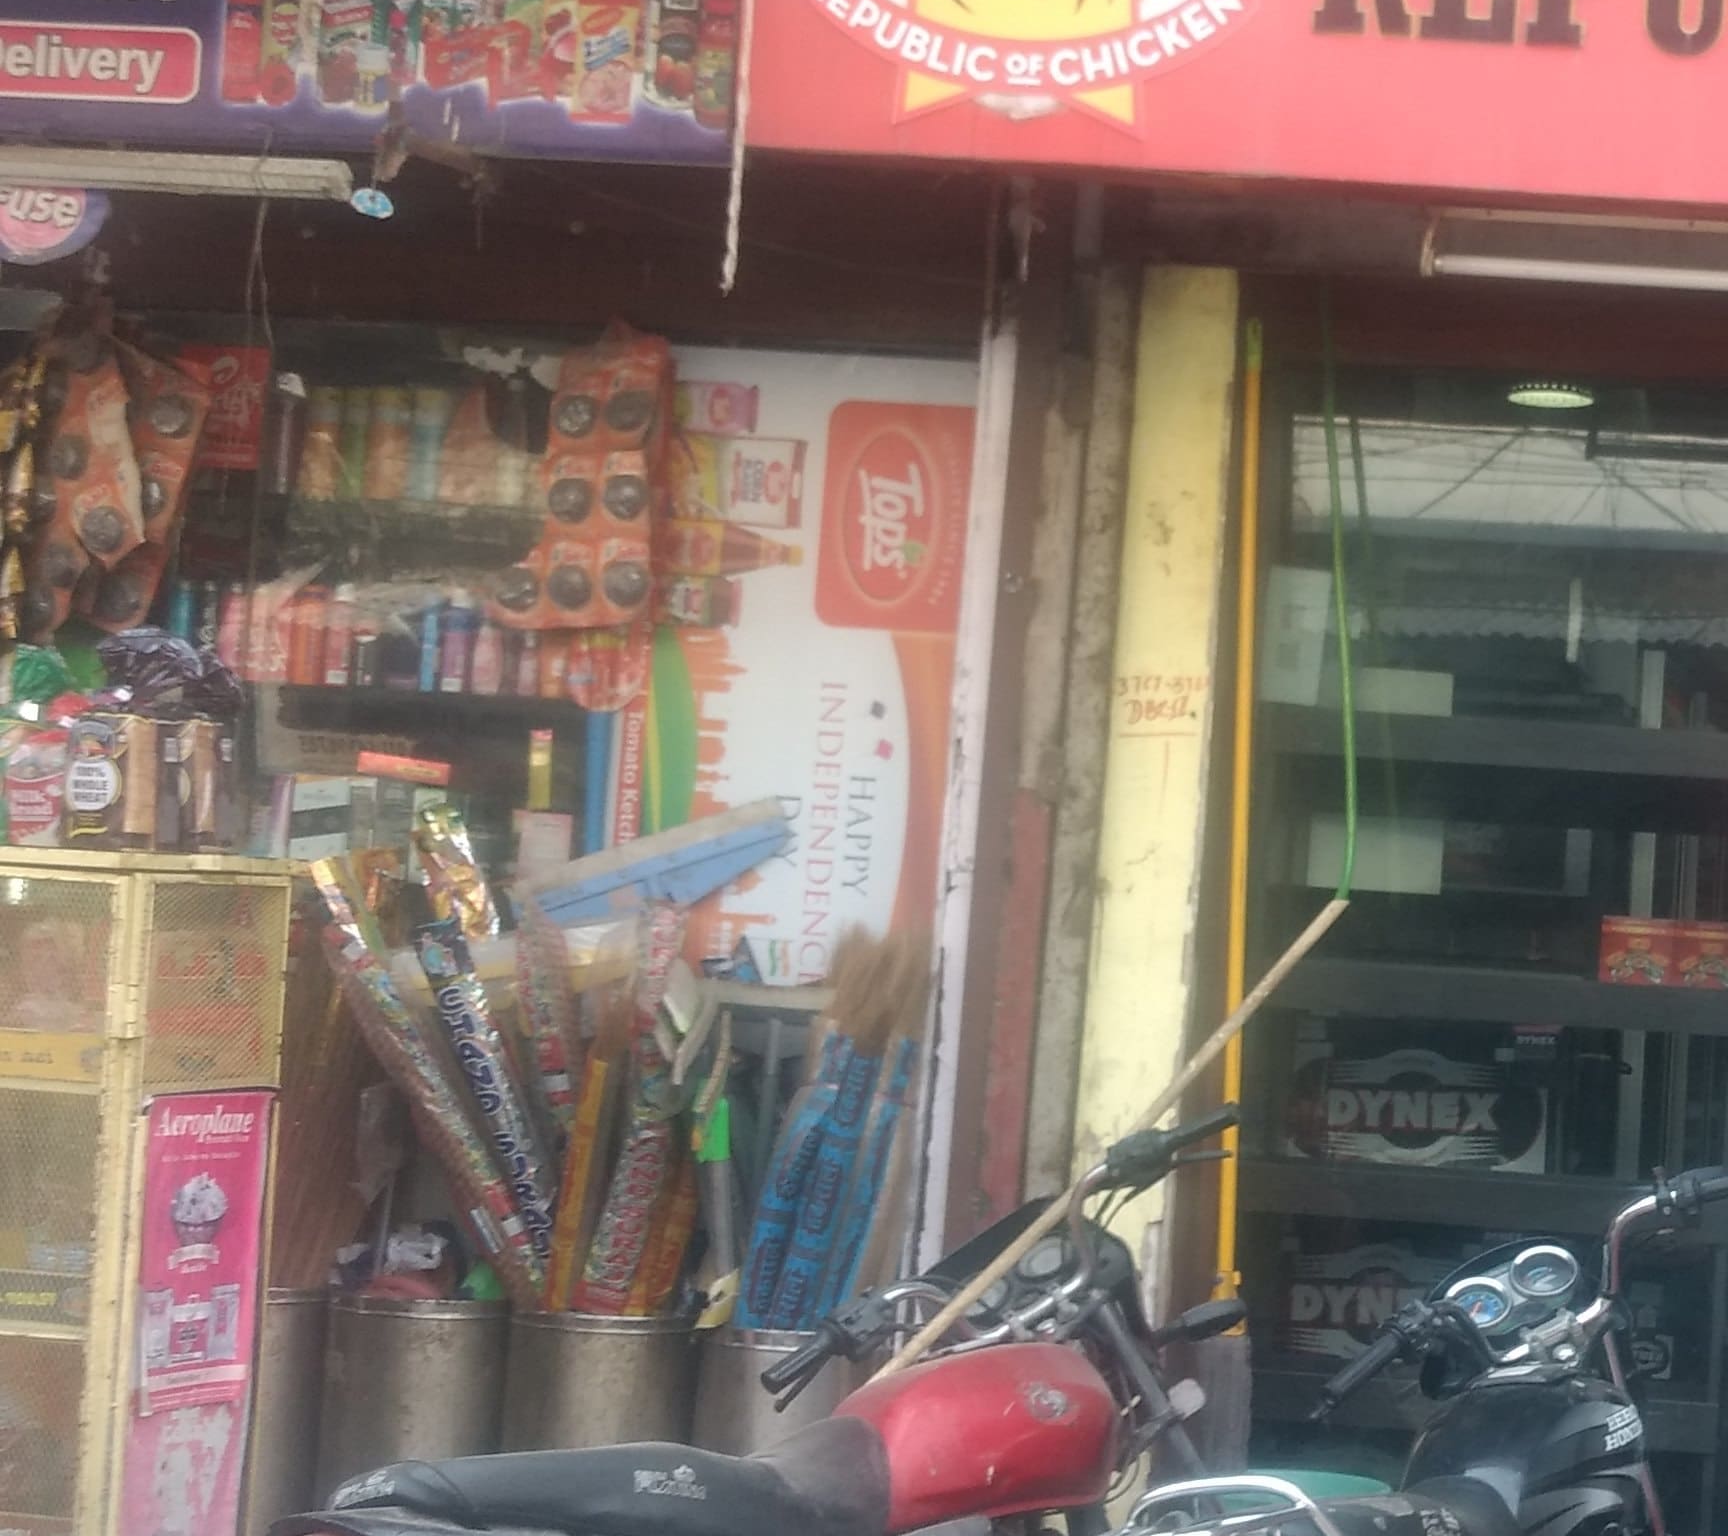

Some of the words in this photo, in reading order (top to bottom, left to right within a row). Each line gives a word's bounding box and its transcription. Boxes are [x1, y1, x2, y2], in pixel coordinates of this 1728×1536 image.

[0, 34, 165, 95] elivery
[1005, 51, 1044, 85] OF
[859, 462, 924, 572] Tops
[841, 774, 877, 897] HAPPY
[153, 1104, 254, 1144] Aeroplane
[1326, 1087, 1500, 1132] DYNEX
